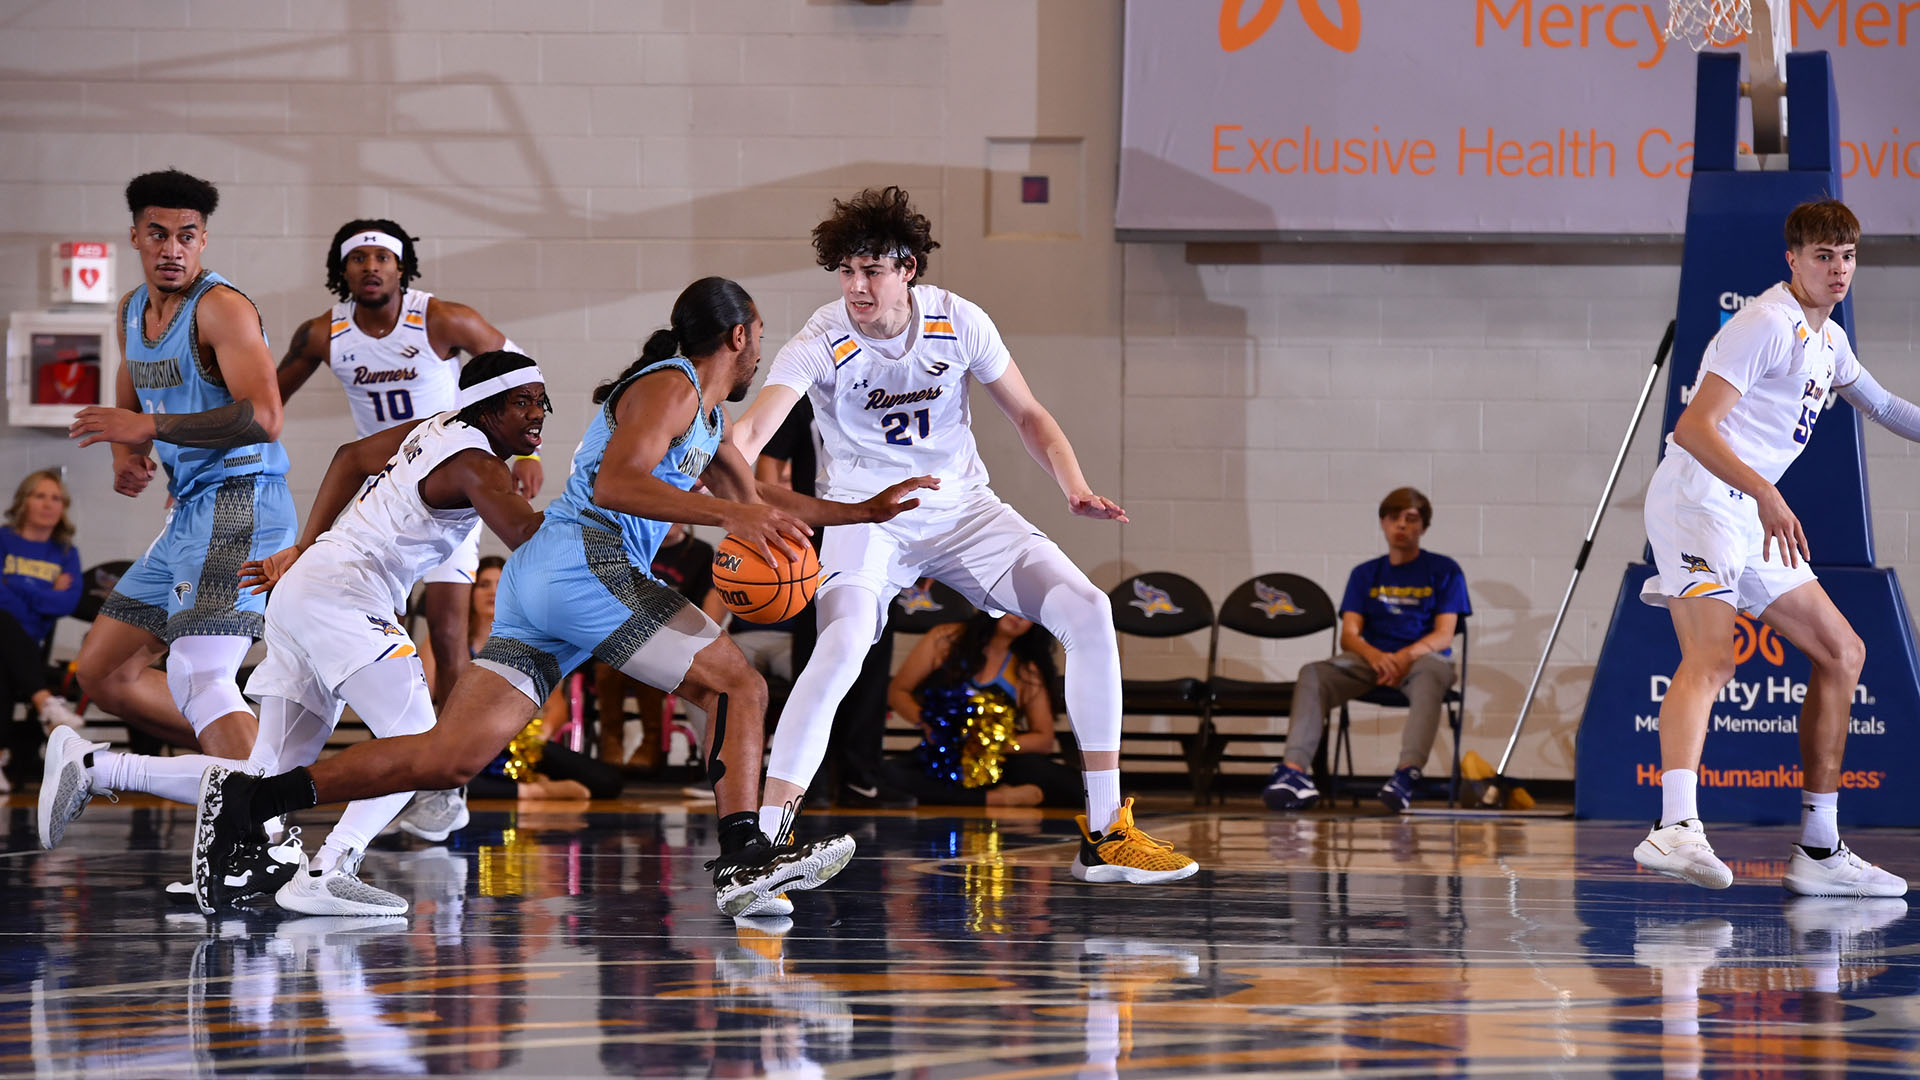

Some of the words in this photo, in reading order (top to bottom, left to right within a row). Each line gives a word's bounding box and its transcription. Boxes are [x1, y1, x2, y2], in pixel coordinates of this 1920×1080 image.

[1475, 0, 1669, 69] Mercy
[1212, 124, 1437, 176] Exclusive
[1457, 126, 1617, 179] Health
[353, 365, 419, 386] Runners
[367, 388, 415, 422] 10
[864, 384, 944, 411] Runners
[880, 407, 930, 446] 21
[1650, 674, 1761, 712] Dity
[1714, 714, 1799, 734] Memorial
